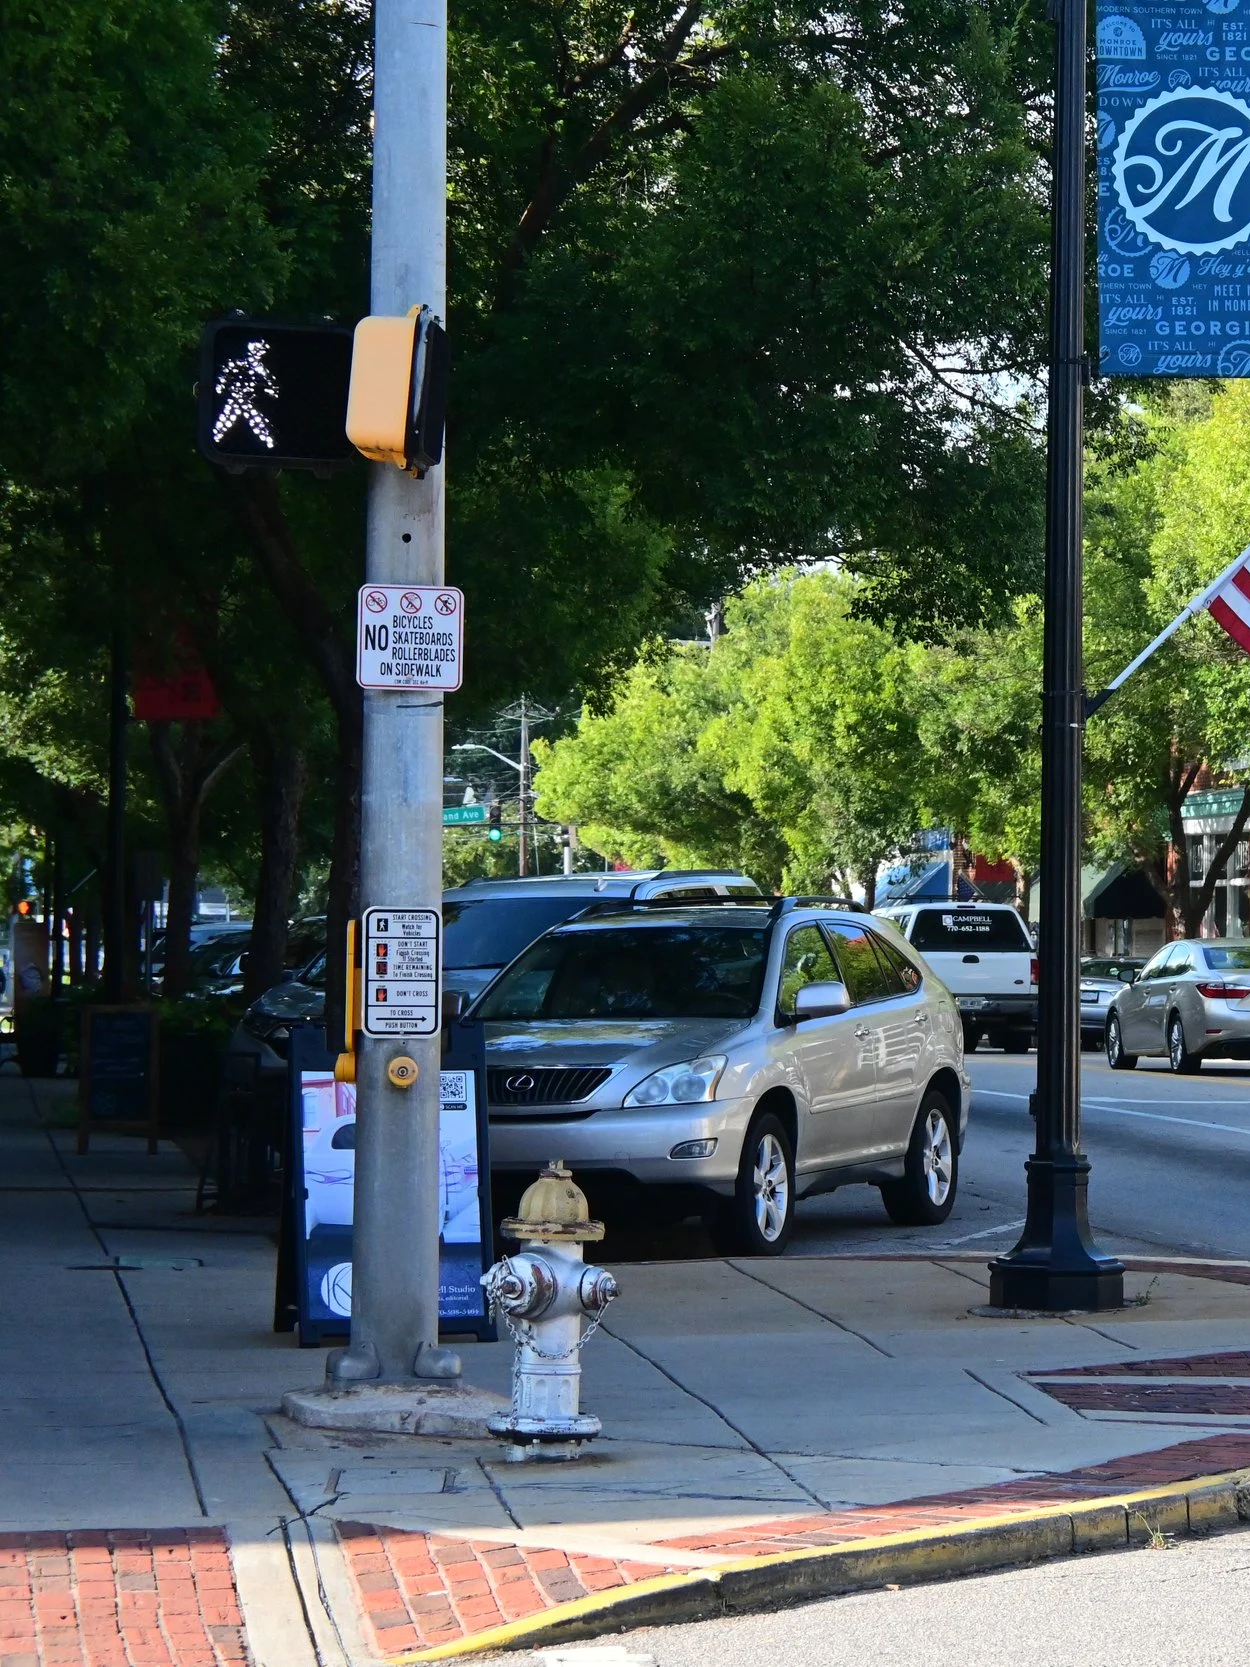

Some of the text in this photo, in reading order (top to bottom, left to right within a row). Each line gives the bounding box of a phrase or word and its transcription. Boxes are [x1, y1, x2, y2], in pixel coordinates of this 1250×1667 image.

[1133, 6, 1177, 14] SOUTHERN
[1180, 7, 1203, 15] TOWN
[1151, 18, 1199, 30] IT'S ALL
[1222, 22, 1248, 31] EST.
[1154, 29, 1214, 52] yours
[1222, 31, 1247, 41] 1821
[1100, 38, 1137, 46] MONROE
[1156, 53, 1178, 61] SINCE
[1198, 66, 1246, 77] IT'S ALL
[1096, 64, 1161, 93] Monroe
[1197, 255, 1231, 279] Hey
[1192, 283, 1208, 291] HEY
[1214, 284, 1242, 297] MEET
[1100, 293, 1148, 305] IT'S ALL
[1171, 296, 1198, 305] EST.
[1171, 306, 1197, 316] 1821
[1208, 299, 1219, 312] IN
[1103, 303, 1164, 327] yours
[1131, 328, 1148, 336] 1821
[1147, 340, 1197, 352] IT'S ALL
[1152, 350, 1213, 375] yours
[392, 614, 434, 630] BICYCLES
[364, 623, 389, 652] NO
[392, 630, 453, 647] SKATEBOARDS
[391, 646, 456, 663] ROLLERBLADES
[379, 661, 442, 678] ON SIDEWALK
[462, 810, 480, 820] Ave
[952, 915, 993, 923] CAMPBELL
[401, 923, 415, 931] Watch
[410, 950, 430, 958] Crossing
[396, 990, 429, 998] DON'T CROSS
[448, 1284, 476, 1294] Studio
